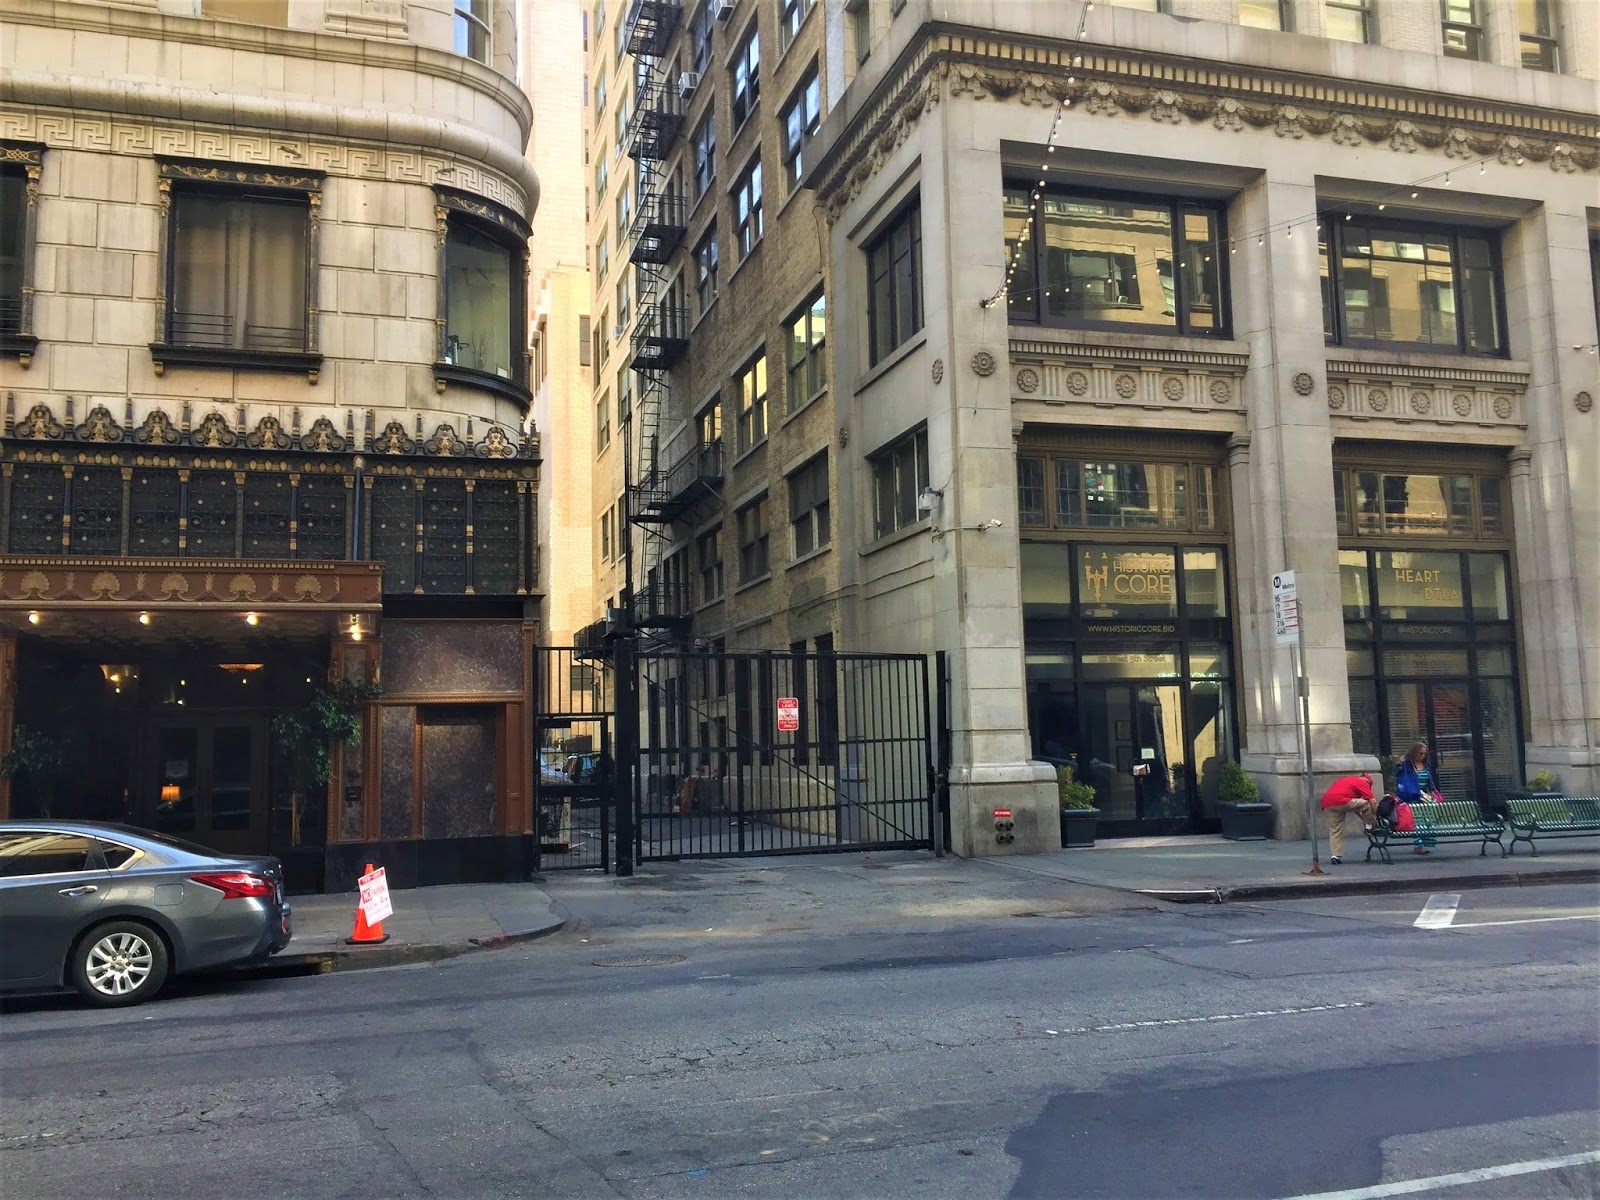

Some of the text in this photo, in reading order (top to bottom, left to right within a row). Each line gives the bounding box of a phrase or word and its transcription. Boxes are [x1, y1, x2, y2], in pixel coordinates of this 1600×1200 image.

[1113, 560, 1171, 573] HISTORIC
[1395, 569, 1441, 583] HEART
[1113, 574, 1172, 594] CORE
[1424, 587, 1460, 601] DTLA
[1087, 624, 1175, 633] WWW.HISTORICCORE.BID
[1128, 655, 1141, 664] 5th
[1143, 655, 1166, 664] Street
